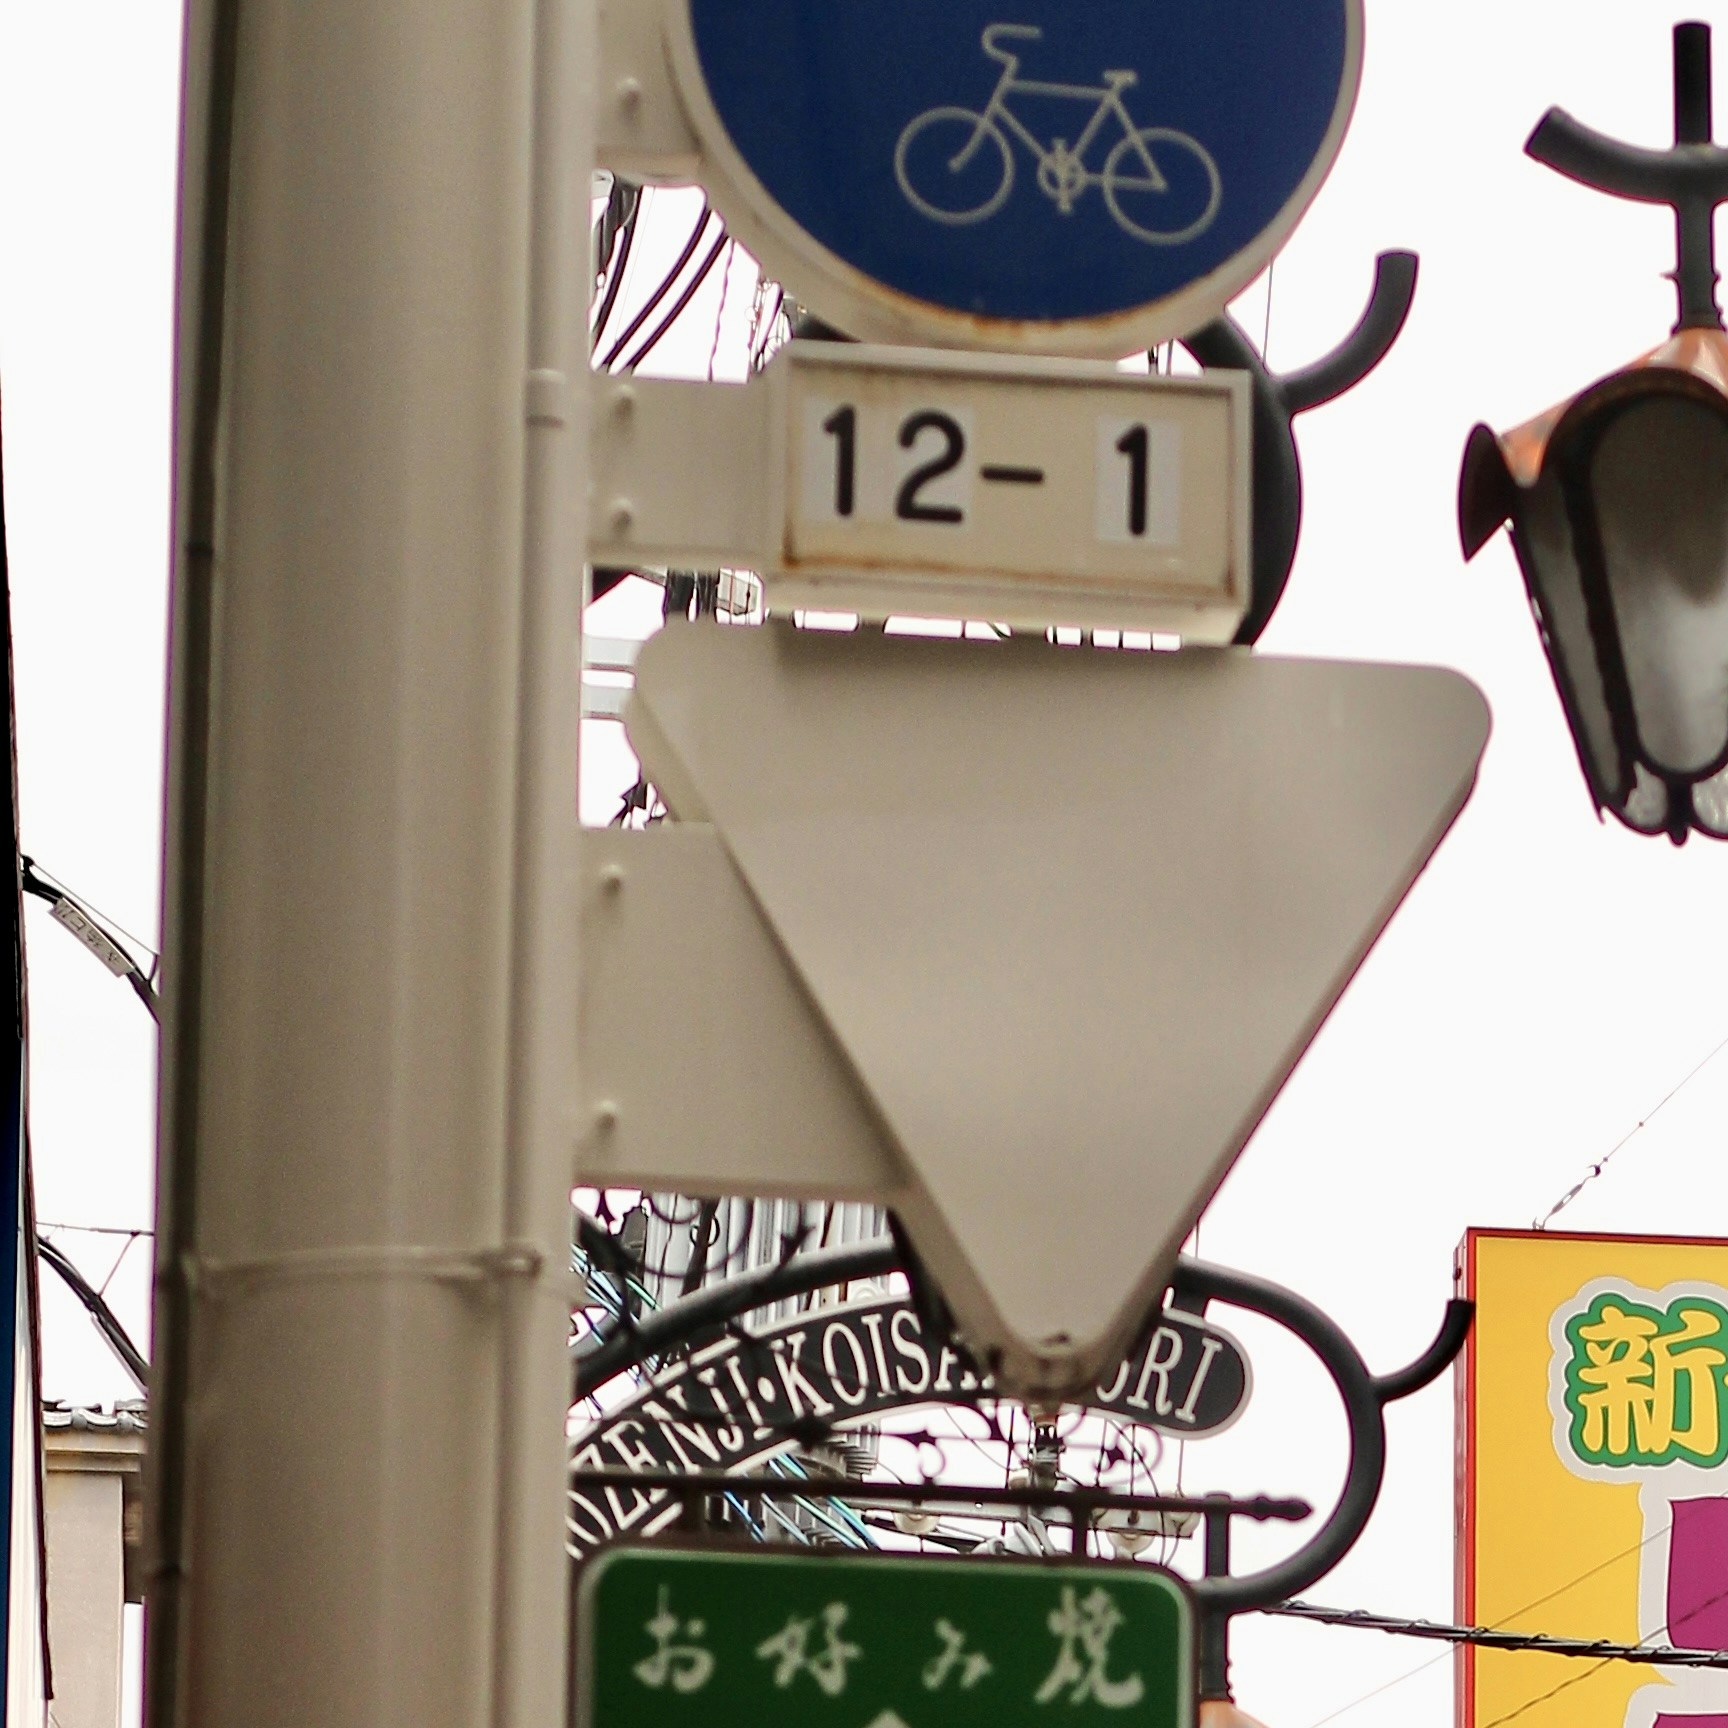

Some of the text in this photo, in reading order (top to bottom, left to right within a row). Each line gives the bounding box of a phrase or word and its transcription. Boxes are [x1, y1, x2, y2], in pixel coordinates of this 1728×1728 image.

[822, 405, 1149, 536] 12-1
[632, 1582, 1144, 1708] お好み焼
